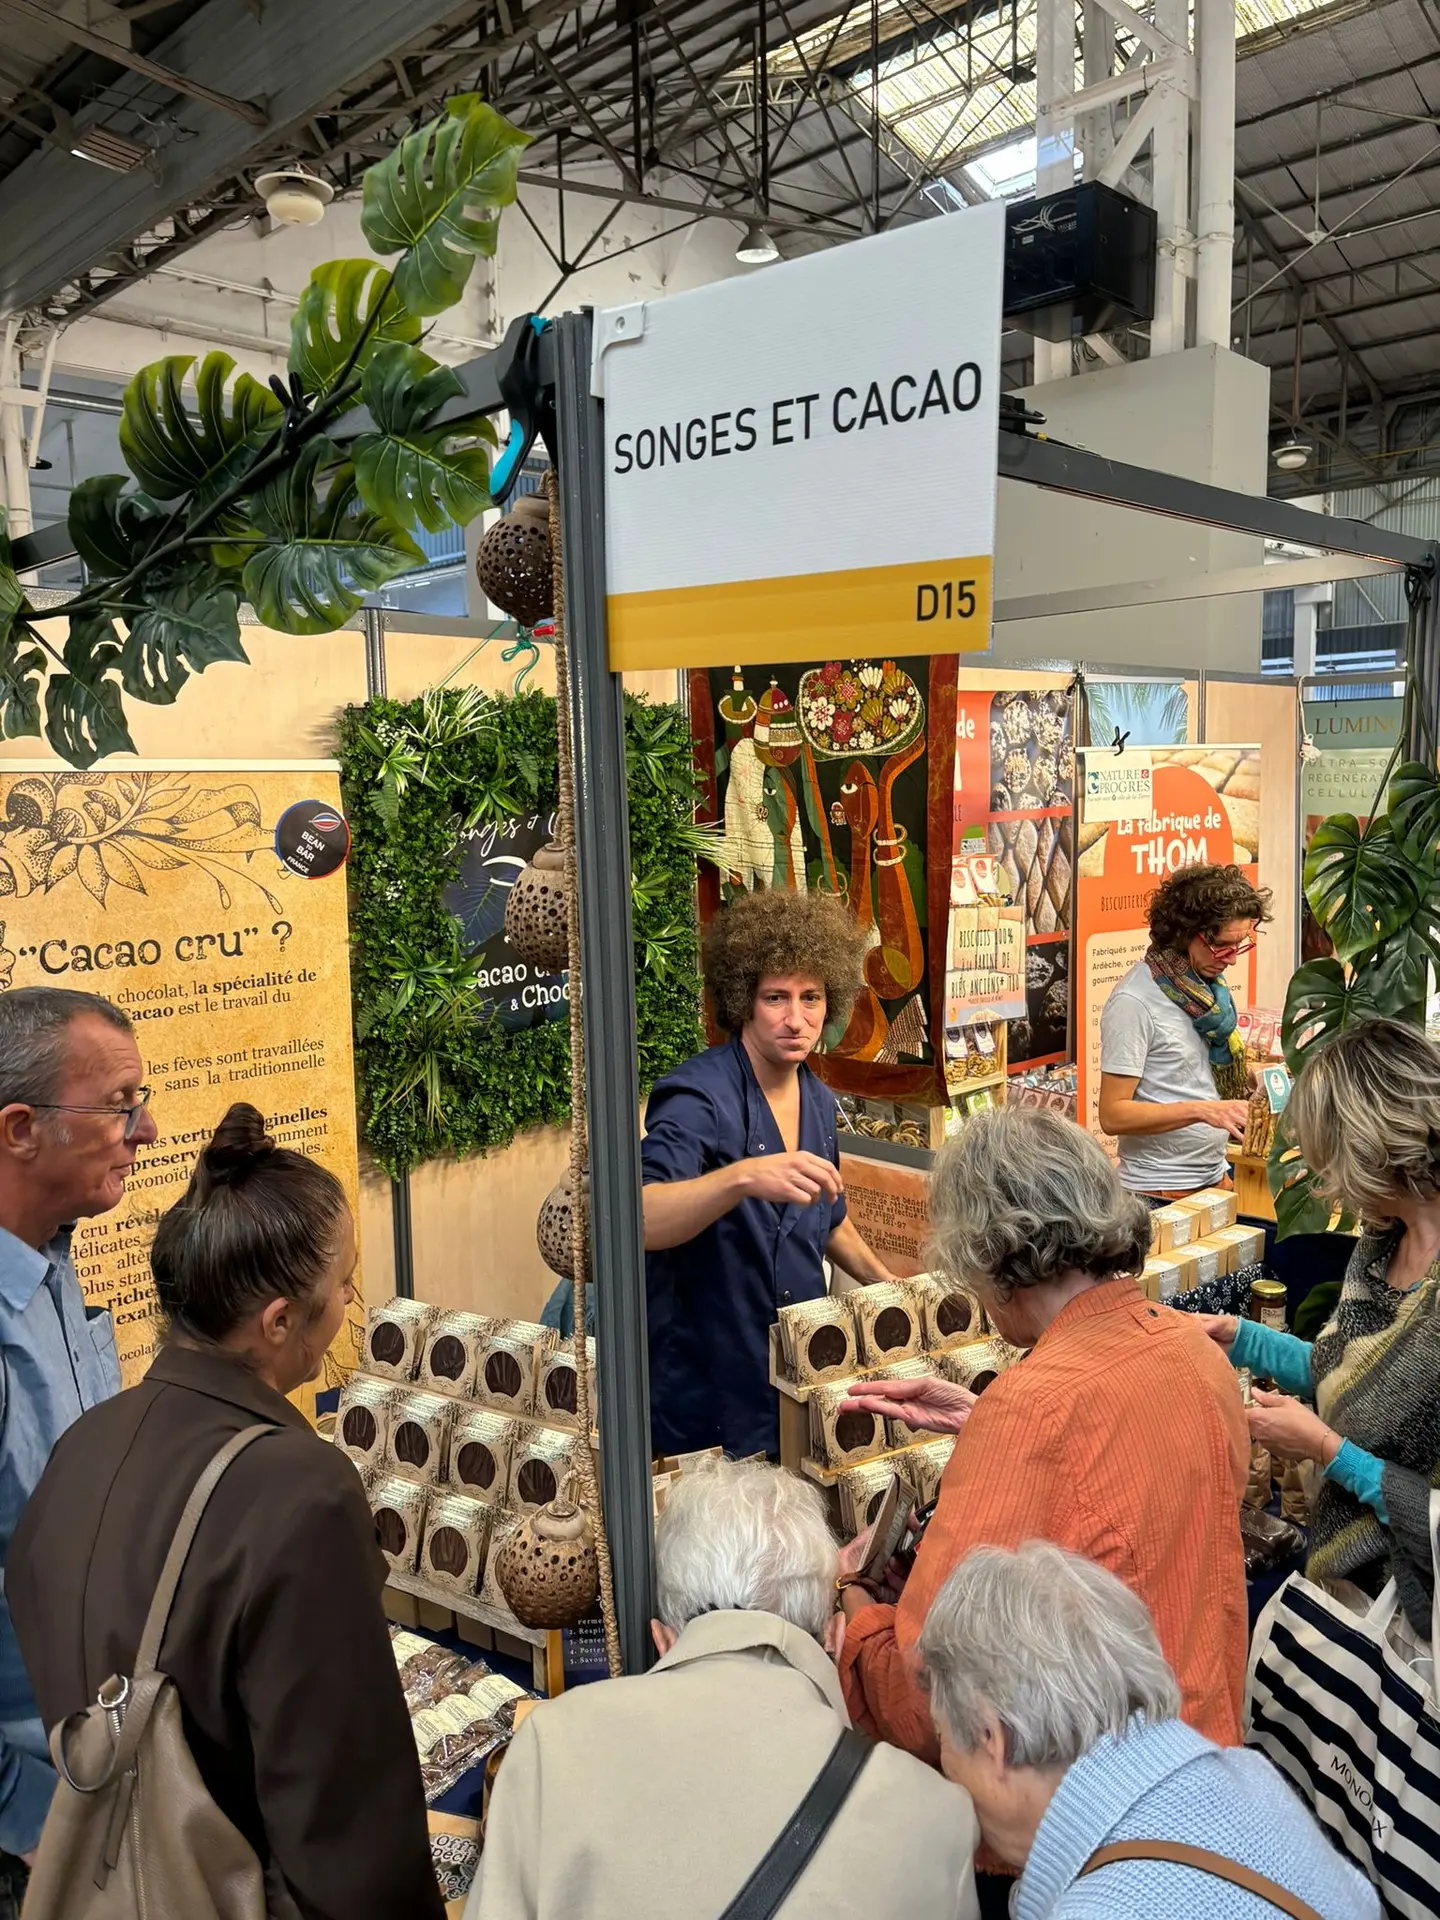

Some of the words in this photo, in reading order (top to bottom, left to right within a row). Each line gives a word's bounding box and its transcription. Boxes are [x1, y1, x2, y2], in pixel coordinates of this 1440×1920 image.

[613, 407, 758, 475] SONGES
[772, 393, 820, 446] ET
[832, 361, 983, 434] CACAO
[916, 579, 976, 622] D15
[956, 708, 976, 740] de
[1316, 716, 1393, 735] LUMIN
[1309, 758, 1357, 768] ULTRA
[1100, 769, 1140, 781] NATURE
[1308, 770, 1384, 783] RÉGÉNÉRA
[1117, 819, 1133, 836] La
[1138, 809, 1201, 838] fabrique
[1204, 806, 1222, 829] de
[301, 830, 325, 852] BEAN
[295, 845, 315, 862] BAR
[1131, 836, 1209, 875] THOM
[286, 856, 310, 874] FRANCE
[271, 920, 293, 953] ?
[1130, 944, 1145, 952] avec
[1092, 959, 1124, 971] Ardèche,
[117, 983, 189, 1004] chocolat,
[193, 980, 208, 995] la
[212, 968, 293, 996] spécialité
[297, 969, 317, 984] de
[178, 1002, 200, 1015] est
[205, 998, 219, 1013] le
[222, 991, 268, 1010] travail
[272, 989, 292, 1005] du
[147, 1060, 169, 1076] les
[173, 1055, 213, 1072] fèves
[216, 1049, 249, 1065] sont
[252, 1038, 324, 1059] travaillées
[164, 1076, 200, 1092] sans
[207, 1070, 221, 1085] la
[228, 1055, 325, 1082] traditionnelle
[171, 1128, 216, 1146] vertu
[265, 1106, 328, 1132] ginelles
[80, 1224, 109, 1240] cru
[74, 1263, 102, 1279] ion
[119, 1269, 152, 1288] stan
[578, 1628, 605, 1636] Respir
[579, 1656, 607, 1664] Savour
